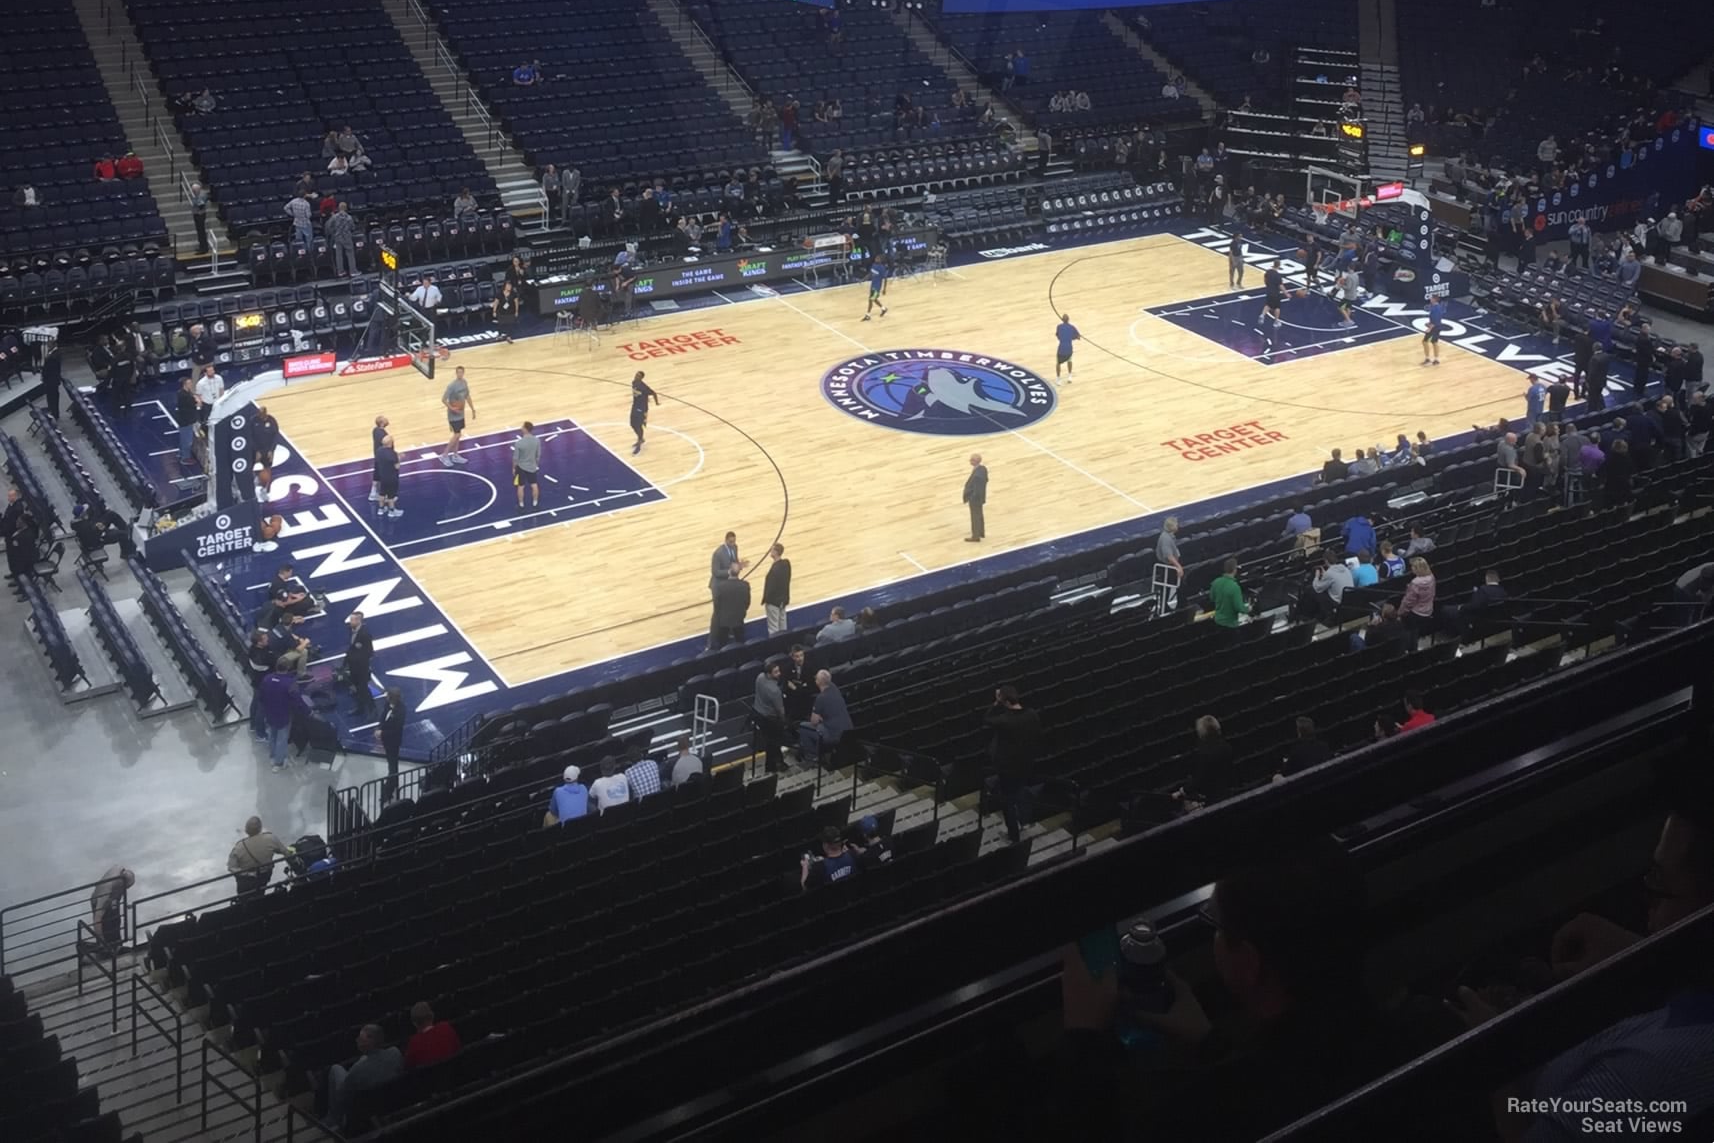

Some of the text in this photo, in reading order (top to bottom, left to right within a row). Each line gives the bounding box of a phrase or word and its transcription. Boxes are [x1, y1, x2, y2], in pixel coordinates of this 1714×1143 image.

[1547, 211, 1567, 226] sun
[695, 268, 712, 276] GAME
[742, 268, 767, 277] KINGS
[672, 279, 693, 287] INSIDE
[707, 273, 724, 281] GAME
[1424, 282, 1450, 293] TARGET
[314, 306, 325, 318] G
[334, 303, 346, 315] G
[353, 301, 364, 312] G
[275, 311, 286, 324] G
[295, 309, 306, 322] G
[214, 320, 225, 334] G
[616, 328, 724, 353] TARGET
[280, 343, 290, 353] G
[628, 336, 742, 361] CENTER
[219, 352, 230, 362] G
[830, 351, 1048, 420] MINNESOTA TIMBERWOLVES
[1160, 421, 1266, 450] TARGET
[1182, 431, 1290, 461] CENTER
[196, 526, 252, 547] TARGET
[197, 537, 253, 558] CENTER
